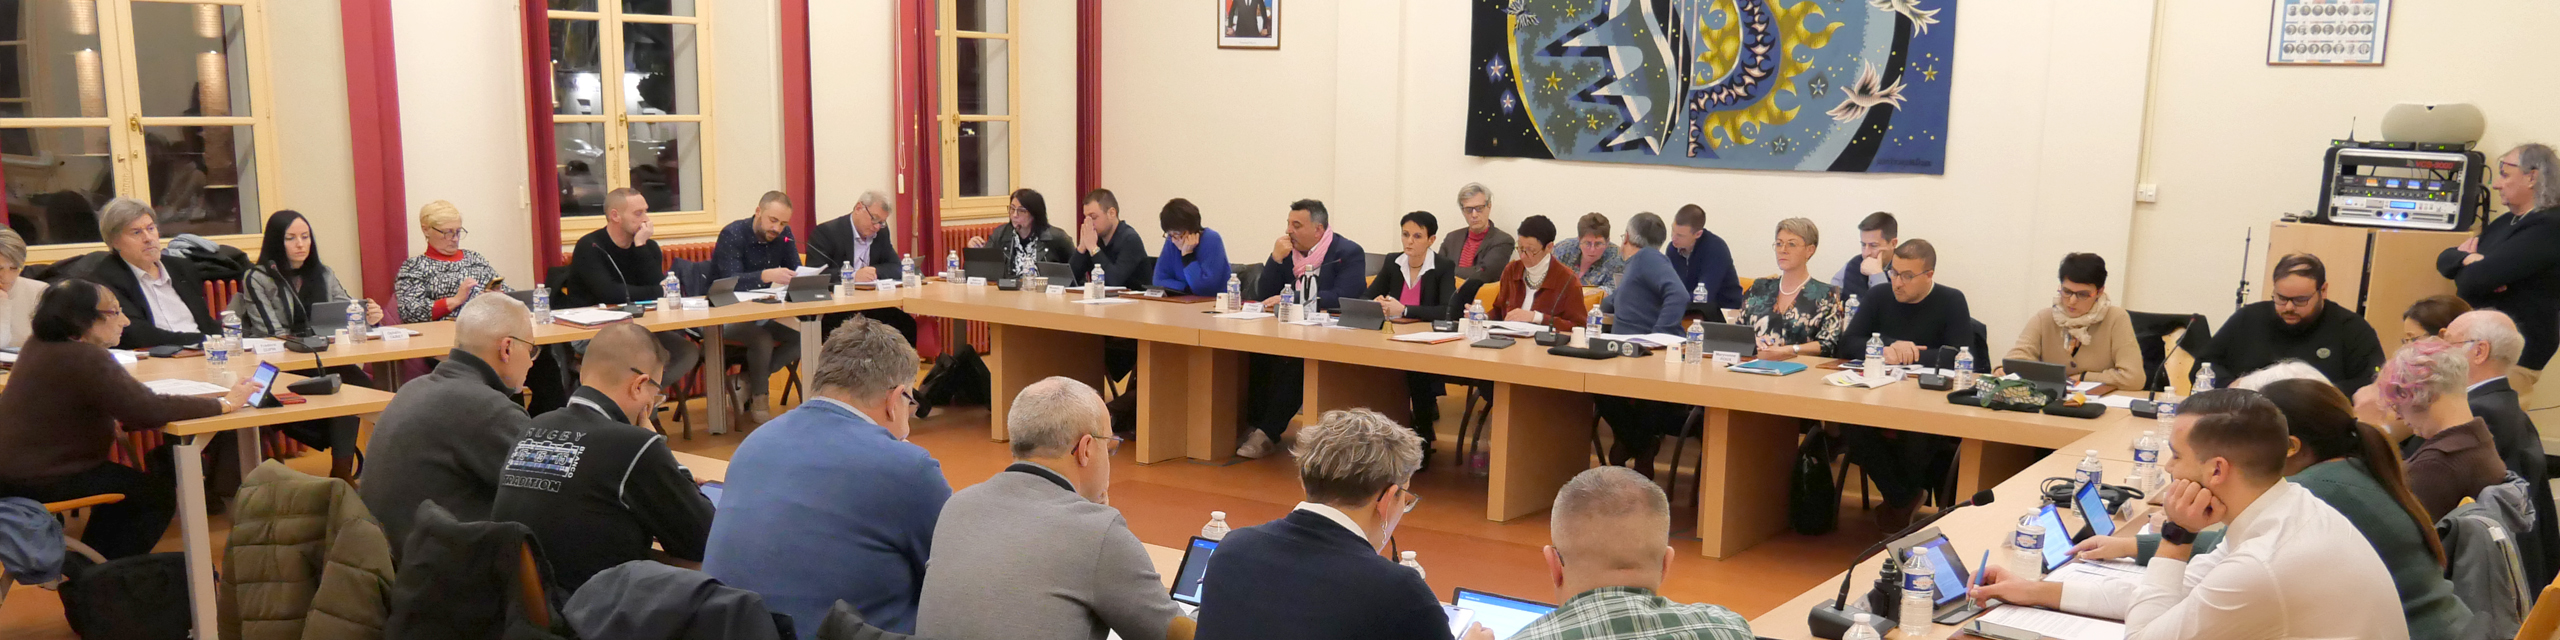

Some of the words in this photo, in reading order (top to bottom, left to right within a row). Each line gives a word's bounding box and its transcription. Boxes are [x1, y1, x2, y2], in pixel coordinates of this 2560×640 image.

[525, 427, 586, 442] RUGBY
[567, 446, 586, 479] BLANCO
[502, 474, 562, 493] TRADITION
